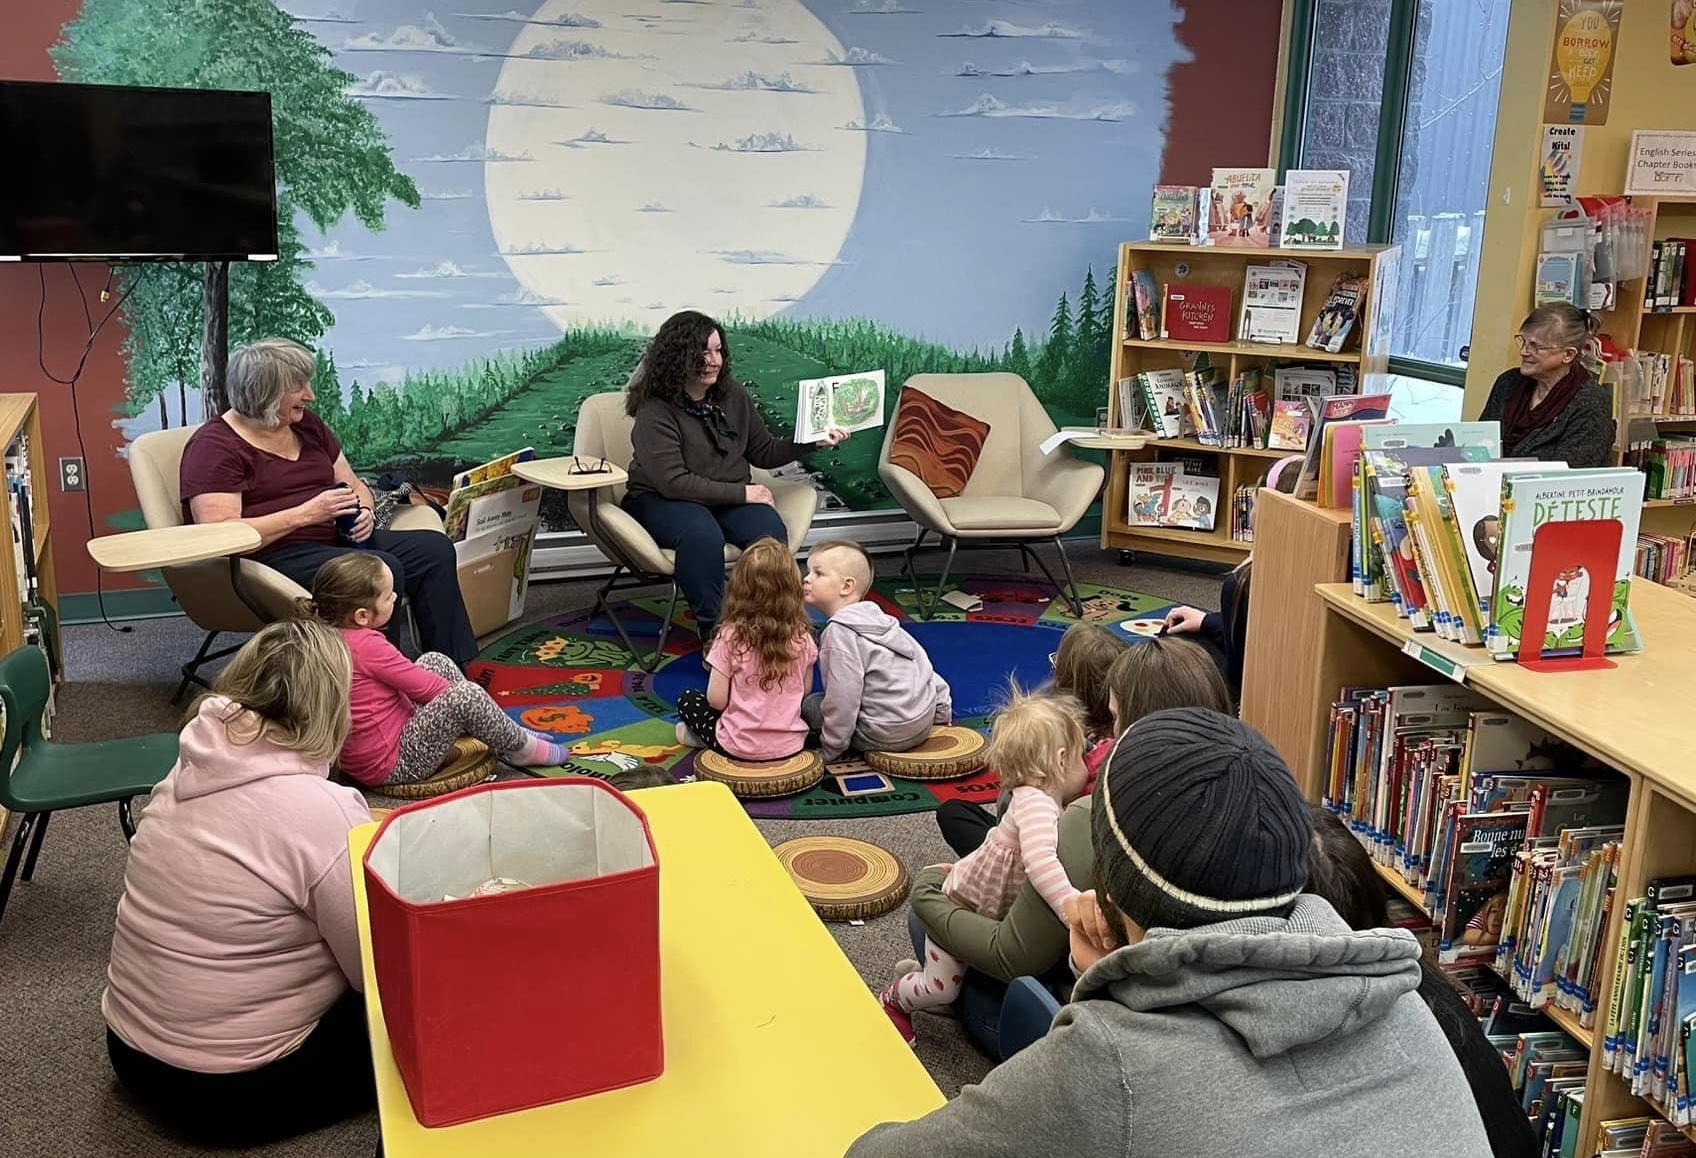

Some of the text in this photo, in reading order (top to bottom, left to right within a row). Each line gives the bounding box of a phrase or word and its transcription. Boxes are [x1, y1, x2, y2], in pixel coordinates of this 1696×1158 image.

[1563, 37, 1610, 48] BORROW
[1549, 127, 1576, 136] Create
[1551, 141, 1571, 151] Kits!
[1639, 147, 1670, 158] English
[1637, 160, 1671, 169] Chapter
[1182, 310, 1214, 322] KITCHEN
[1535, 490, 1566, 500] ALBERTINE
[1533, 497, 1622, 527] DÉTESTE
[1472, 829, 1526, 844] Bonne nu
[1490, 843, 1508, 858] les
